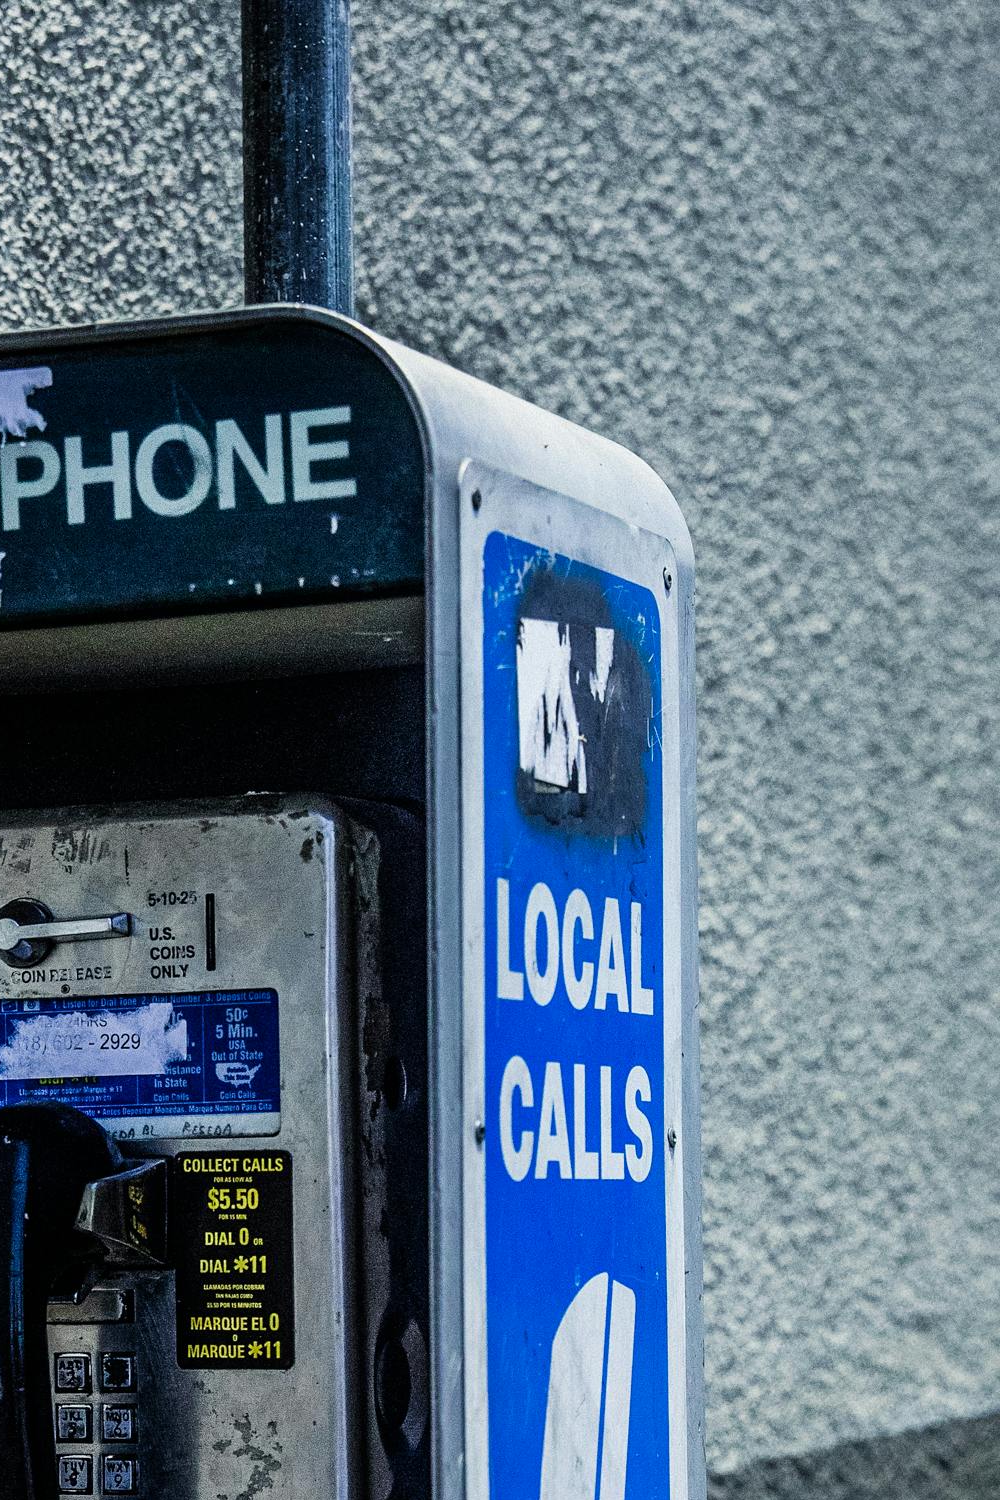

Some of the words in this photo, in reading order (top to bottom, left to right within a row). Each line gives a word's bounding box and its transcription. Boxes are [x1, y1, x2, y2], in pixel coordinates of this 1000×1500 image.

[1, 406, 357, 531] PHONE
[149, 926, 176, 941] U.S.
[150, 945, 196, 961] COINS
[497, 877, 654, 1015] LOCAL
[11, 969, 46, 985] COIN
[150, 964, 190, 979] ONLY
[225, 1007, 249, 1022] 50¢
[215, 1024, 224, 1039] 5
[228, 1023, 258, 1039] Min.
[100, 1033, 141, 1050] 2929
[228, 1039, 246, 1050] USA
[211, 1051, 227, 1062] Out
[228, 1051, 238, 1061] of
[240, 1050, 264, 1060] State
[154, 1078, 163, 1088] In
[164, 1077, 188, 1088] State
[153, 1093, 170, 1102] Coin
[171, 1092, 190, 1101] Calls
[219, 1091, 236, 1100] Coin
[237, 1090, 256, 1099] Calls
[499, 1055, 653, 1182] CALLS
[182, 1121, 232, 1137] RESEDA
[183, 1157, 239, 1172] COLLECT
[242, 1157, 283, 1172] CALLS
[207, 1186, 259, 1212] $5.50
[204, 1231, 236, 1246] DIAL
[239, 1227, 250, 1246] 0
[253, 1237, 264, 1246] OR
[199, 1259, 230, 1274] DIAL
[190, 1316, 248, 1333] MARQUE
[251, 1316, 267, 1331] EL
[269, 1312, 280, 1331] 0
[187, 1344, 245, 1361] MARQUE
[62, 1411, 83, 1421] JKL
[113, 1420, 122, 1436] 6
[63, 1461, 86, 1473] TUV
[106, 1461, 130, 1473] WXY
[114, 1473, 123, 1488] 9
